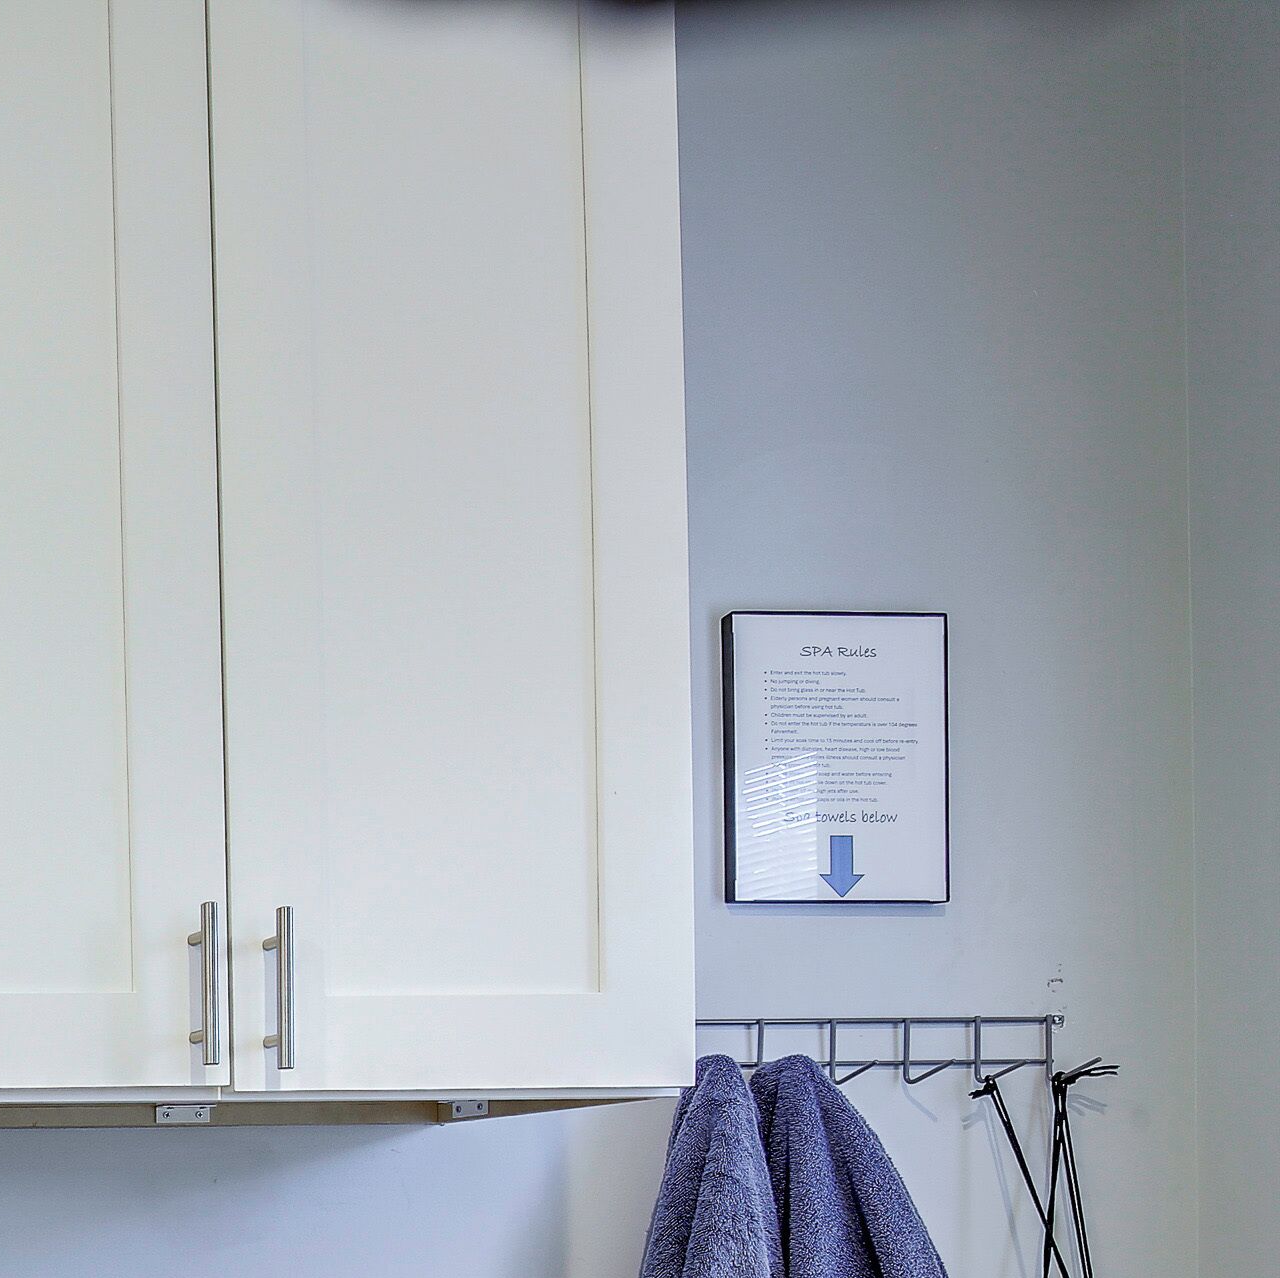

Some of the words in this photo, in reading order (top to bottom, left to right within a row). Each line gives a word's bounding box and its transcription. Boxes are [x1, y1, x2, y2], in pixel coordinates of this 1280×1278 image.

[800, 646, 832, 657] SPA
[837, 645, 877, 657] Rules
[815, 810, 856, 823] towels
[861, 810, 898, 823] below
